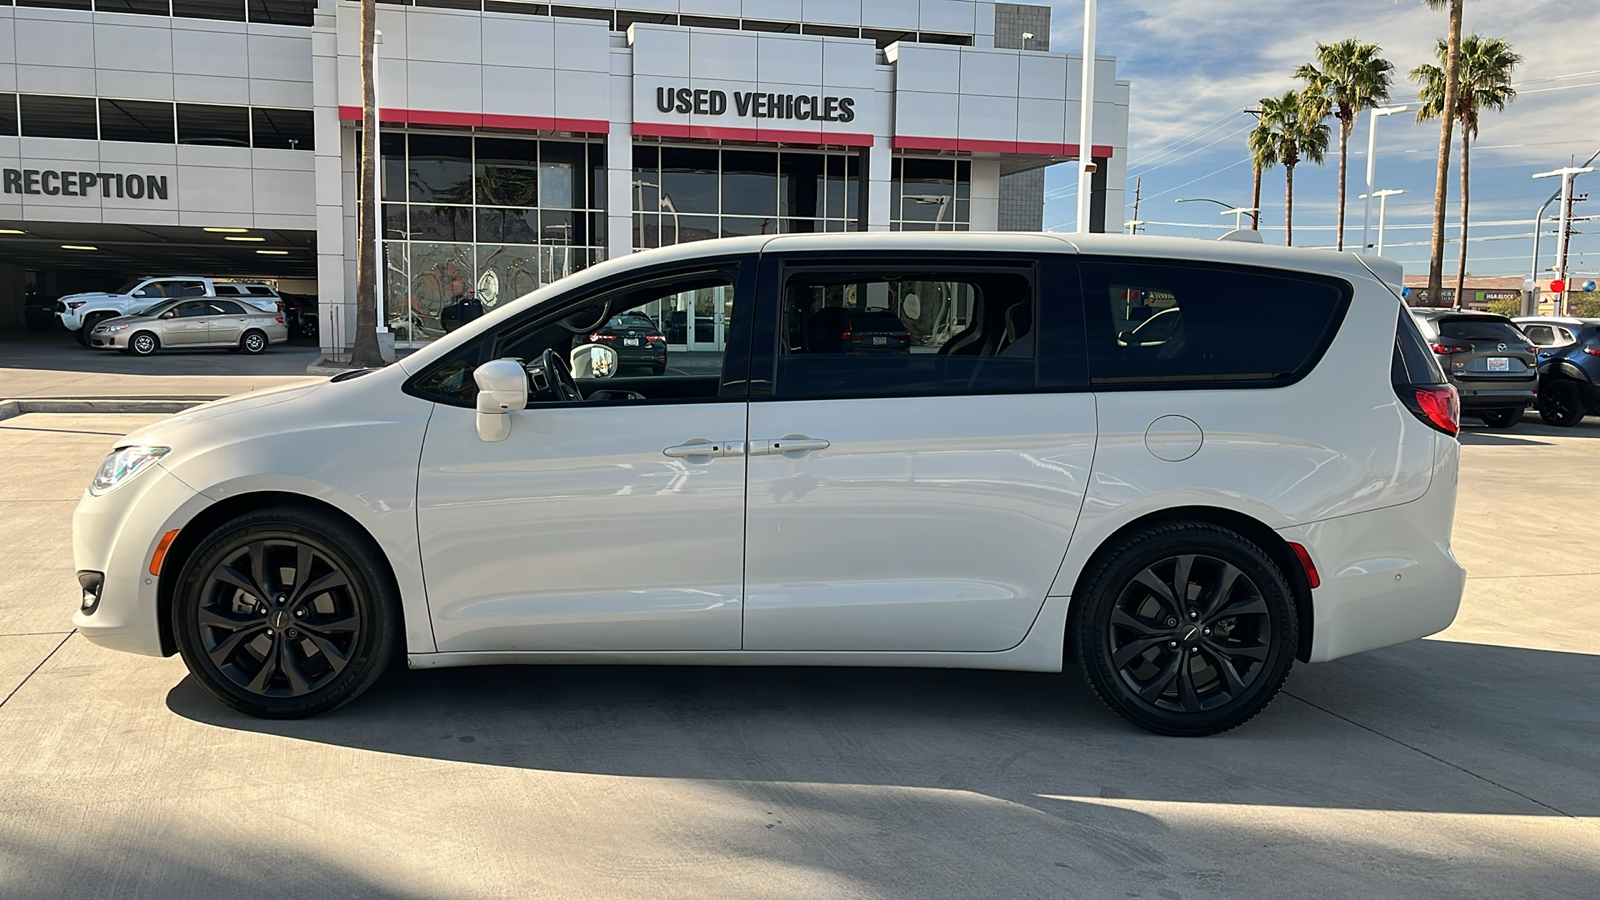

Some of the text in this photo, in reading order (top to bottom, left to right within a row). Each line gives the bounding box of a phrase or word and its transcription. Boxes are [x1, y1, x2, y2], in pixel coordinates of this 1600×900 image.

[656, 86, 855, 122] USED VEHICLES
[3, 168, 168, 200] RECEPTION
